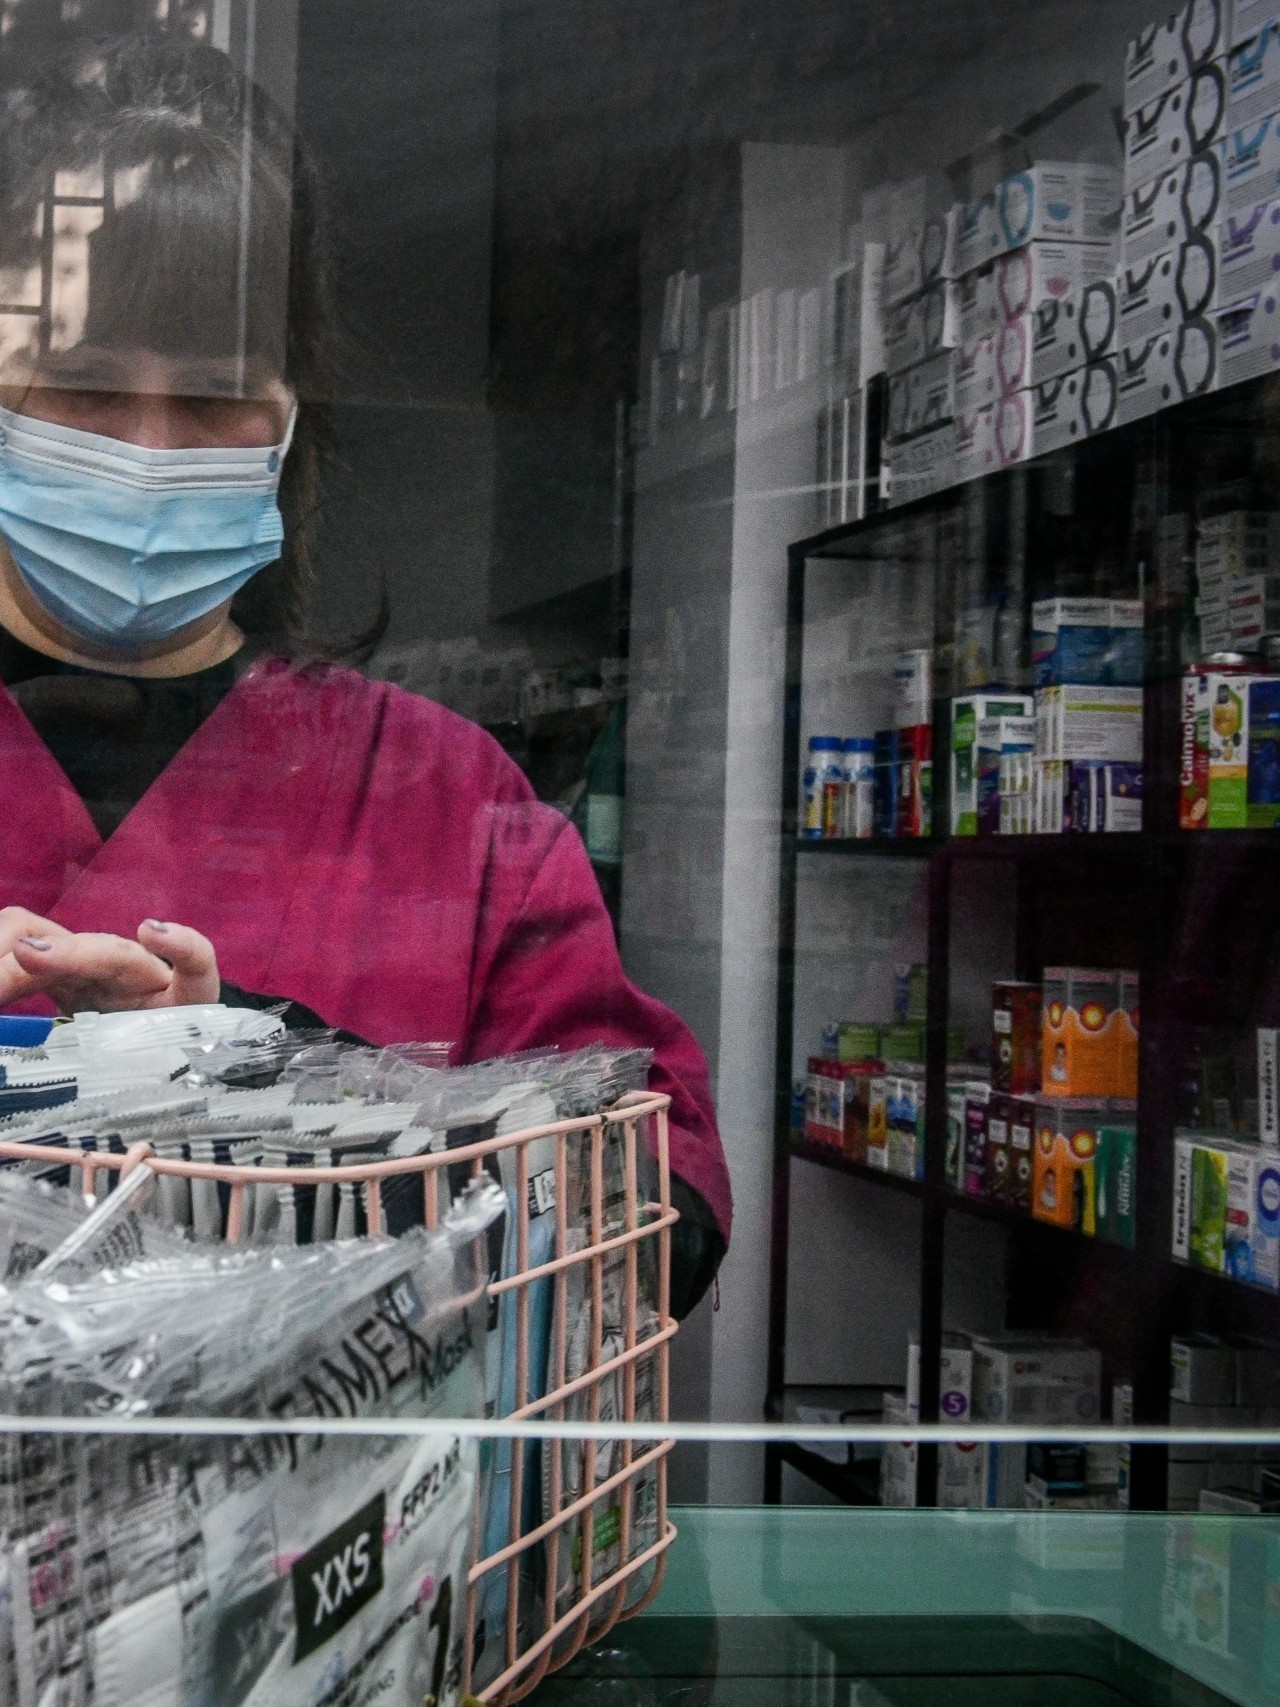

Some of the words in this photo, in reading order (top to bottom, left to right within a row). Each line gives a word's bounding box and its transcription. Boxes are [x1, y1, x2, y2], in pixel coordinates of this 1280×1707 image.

[1180, 693, 1195, 786] Calmovix
[270, 1287, 432, 1472] FAMEX
[948, 1393, 961, 1413] S
[401, 1462, 439, 1527] FFP2
[311, 1532, 370, 1626] XXS
